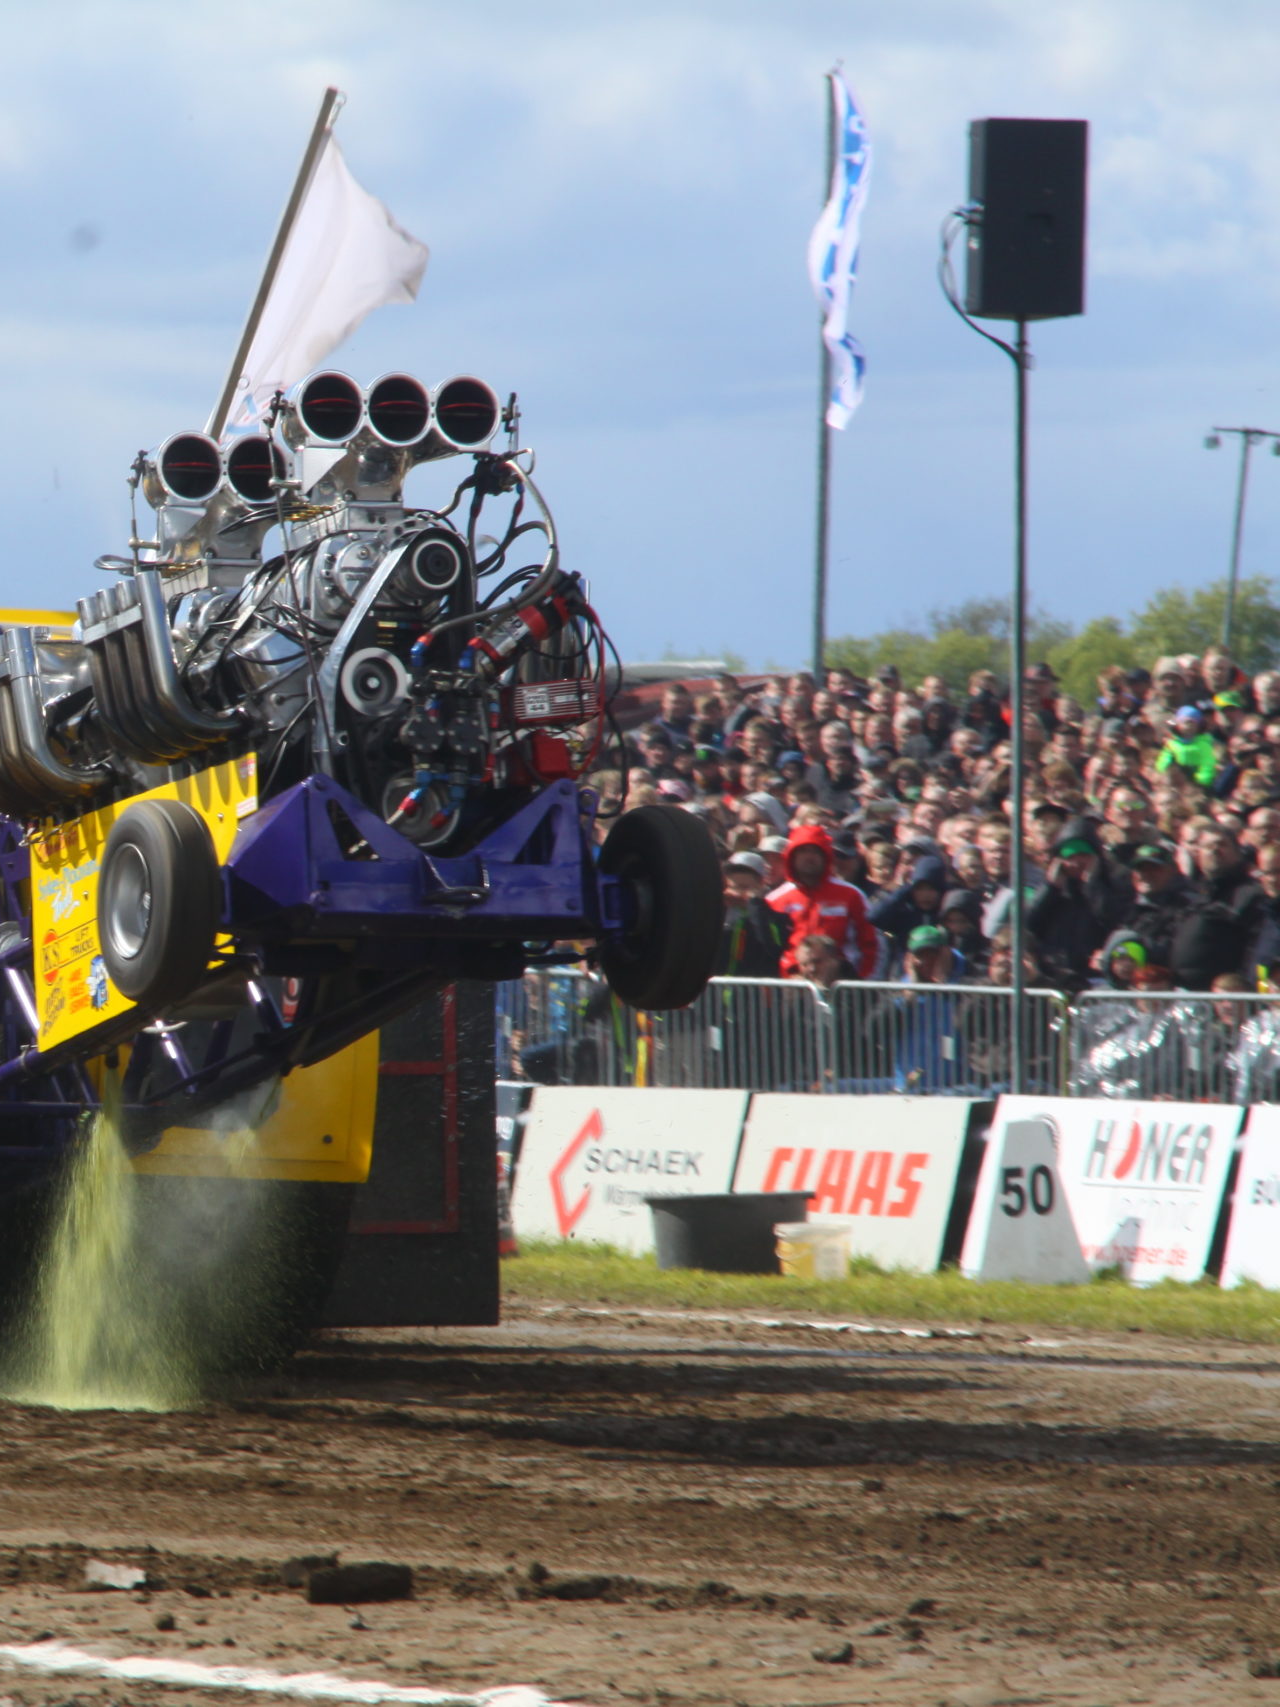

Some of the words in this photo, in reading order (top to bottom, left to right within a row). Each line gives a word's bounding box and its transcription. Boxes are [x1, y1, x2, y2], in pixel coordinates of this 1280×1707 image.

[584, 1149, 704, 1176] SCHAEK
[762, 1147, 930, 1218] CLAAS
[1000, 1163, 1055, 1218] 50
